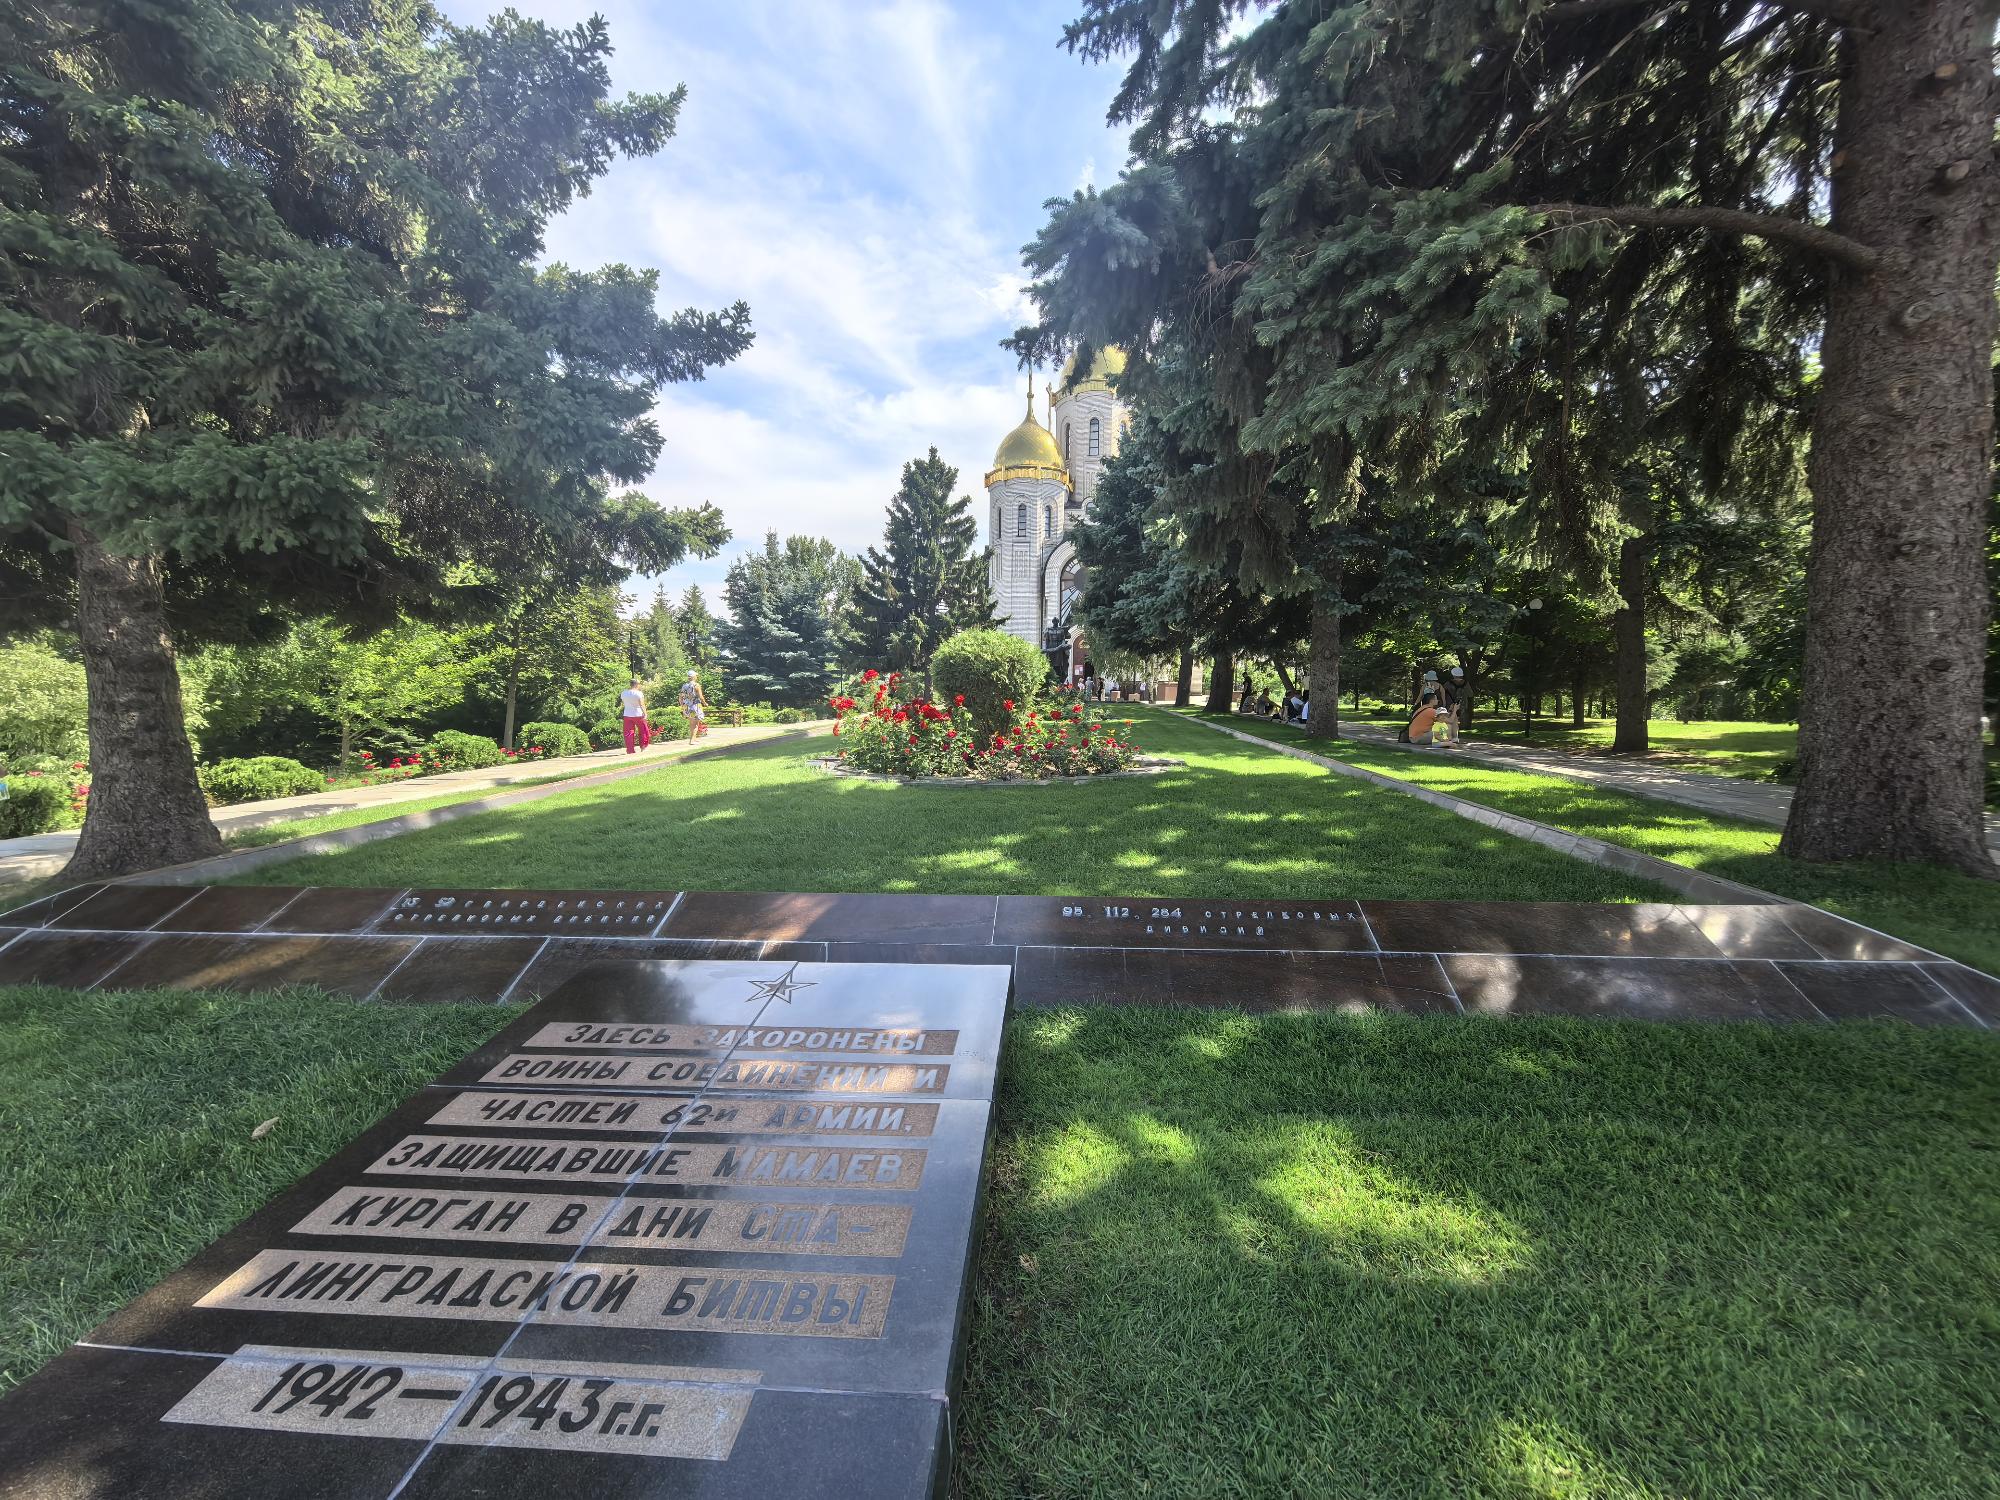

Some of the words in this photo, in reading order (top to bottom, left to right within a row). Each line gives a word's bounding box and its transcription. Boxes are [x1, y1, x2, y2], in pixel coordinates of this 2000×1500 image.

[1151, 906, 1183, 918] 284
[564, 1024, 671, 1045] ЗДЕСЬ
[692, 1028, 927, 1051] ЗАХОРОНЕНЫ
[499, 1059, 632, 1080] ВОИНЫ
[914, 1068, 939, 1089] И
[480, 1098, 640, 1124] ЧАСТЕЙ
[386, 1142, 692, 1176] ЗАЩИЩАВШИЕ
[712, 1147, 903, 1184] МАМАЕВ
[332, 1193, 532, 1234] КУРГАН
[546, 1203, 589, 1234] В
[607, 1205, 713, 1240] ДНИ
[243, 1260, 640, 1314] ЛИНГРАДСКОЙ
[661, 1277, 872, 1326] БИТВЫ
